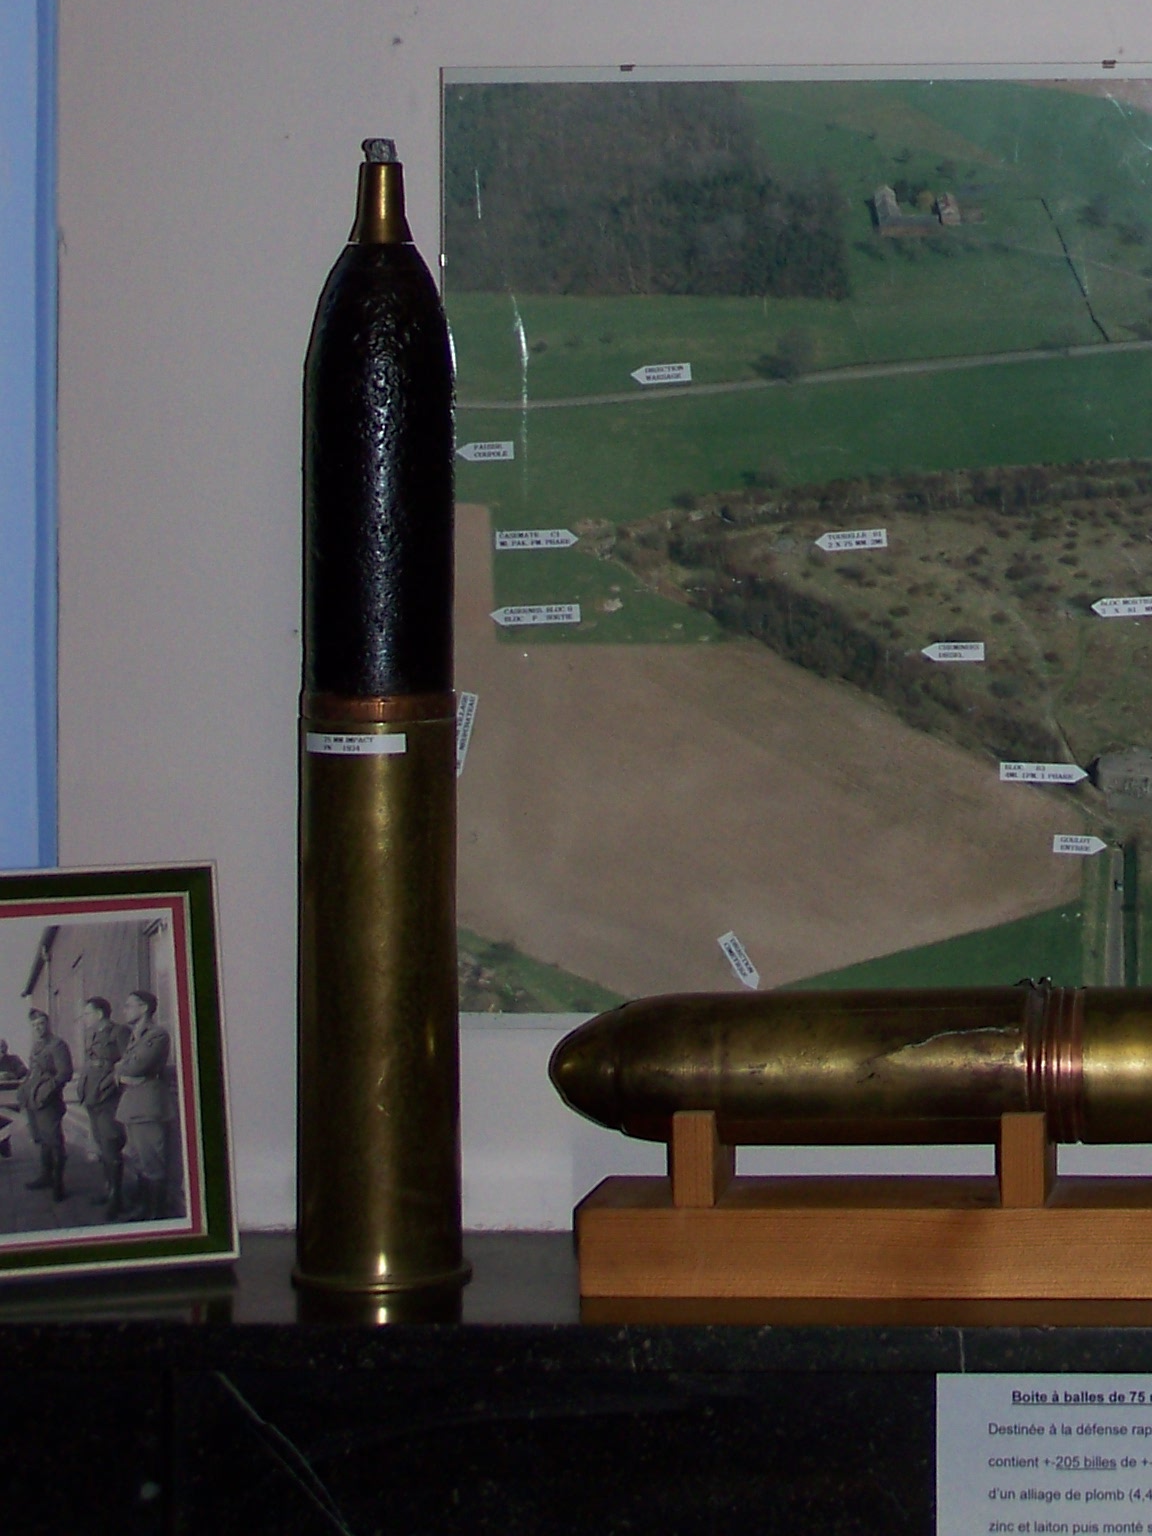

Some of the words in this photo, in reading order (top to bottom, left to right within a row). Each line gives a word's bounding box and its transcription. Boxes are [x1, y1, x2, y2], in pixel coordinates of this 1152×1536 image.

[1011, 1390, 1048, 1403] Boite
[1051, 1390, 1060, 1403] à
[1063, 1390, 1105, 1403] balles
[1108, 1390, 1126, 1403] de
[1128, 1390, 1146, 1403] 75
[987, 1422, 1046, 1436] Destinée
[1048, 1422, 1058, 1436] à
[1060, 1422, 1073, 1437] la
[1075, 1422, 1129, 1436] défense
[987, 1455, 1040, 1469] contient
[1043, 1455, 1081, 1469] +-205
[1083, 1455, 1118, 1469] billes
[1120, 1455, 1138, 1469] de
[987, 1487, 1016, 1501] d'un
[1019, 1487, 1062, 1504] alliage
[1064, 1488, 1082, 1502] de
[1084, 1488, 1125, 1504] plomb
[988, 1519, 1015, 1534] zinc
[1017, 1520, 1031, 1534] et
[1033, 1519, 1069, 1534] laiton
[1072, 1523, 1100, 1536] puis
[1102, 1521, 1144, 1534] monté
